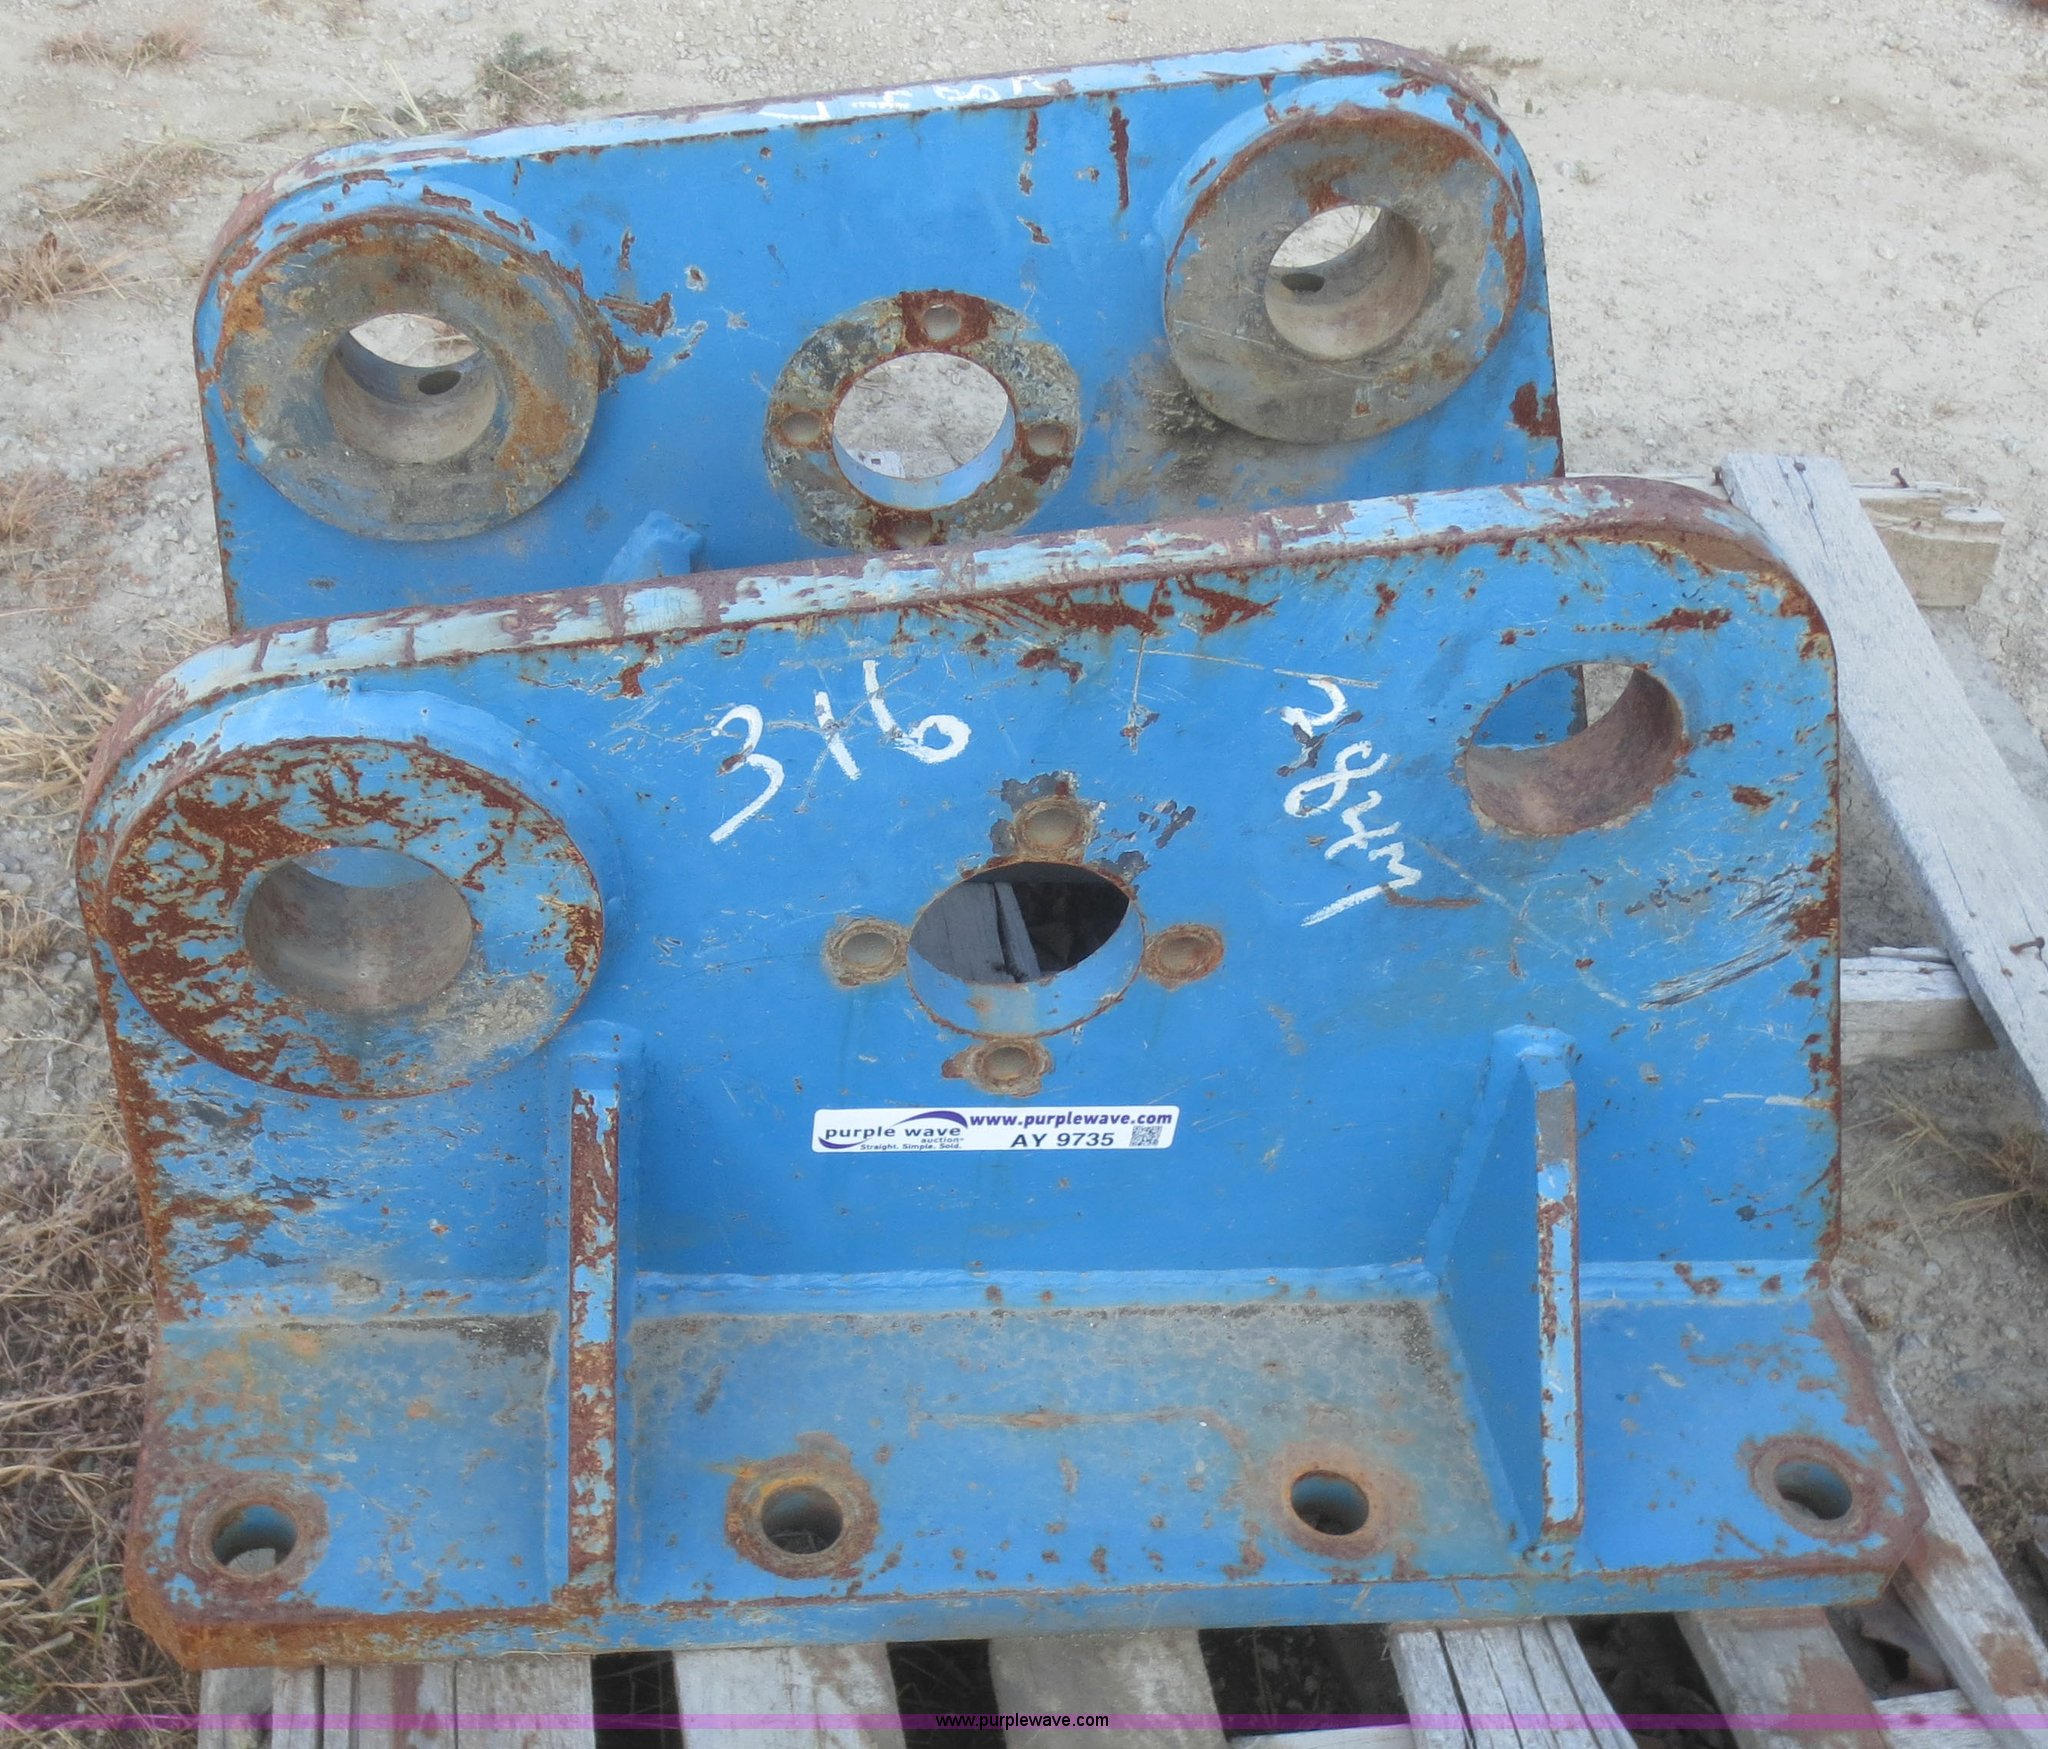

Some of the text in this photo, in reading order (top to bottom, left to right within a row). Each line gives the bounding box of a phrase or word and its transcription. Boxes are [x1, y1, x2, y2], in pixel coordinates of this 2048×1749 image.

[970, 1111, 1172, 1128] www.purplewave.com
[825, 1126, 961, 1140] purple wave
[1010, 1132, 1115, 1148] AY 9735
[860, 1142, 962, 1151] Straight. Simple. Sold.
